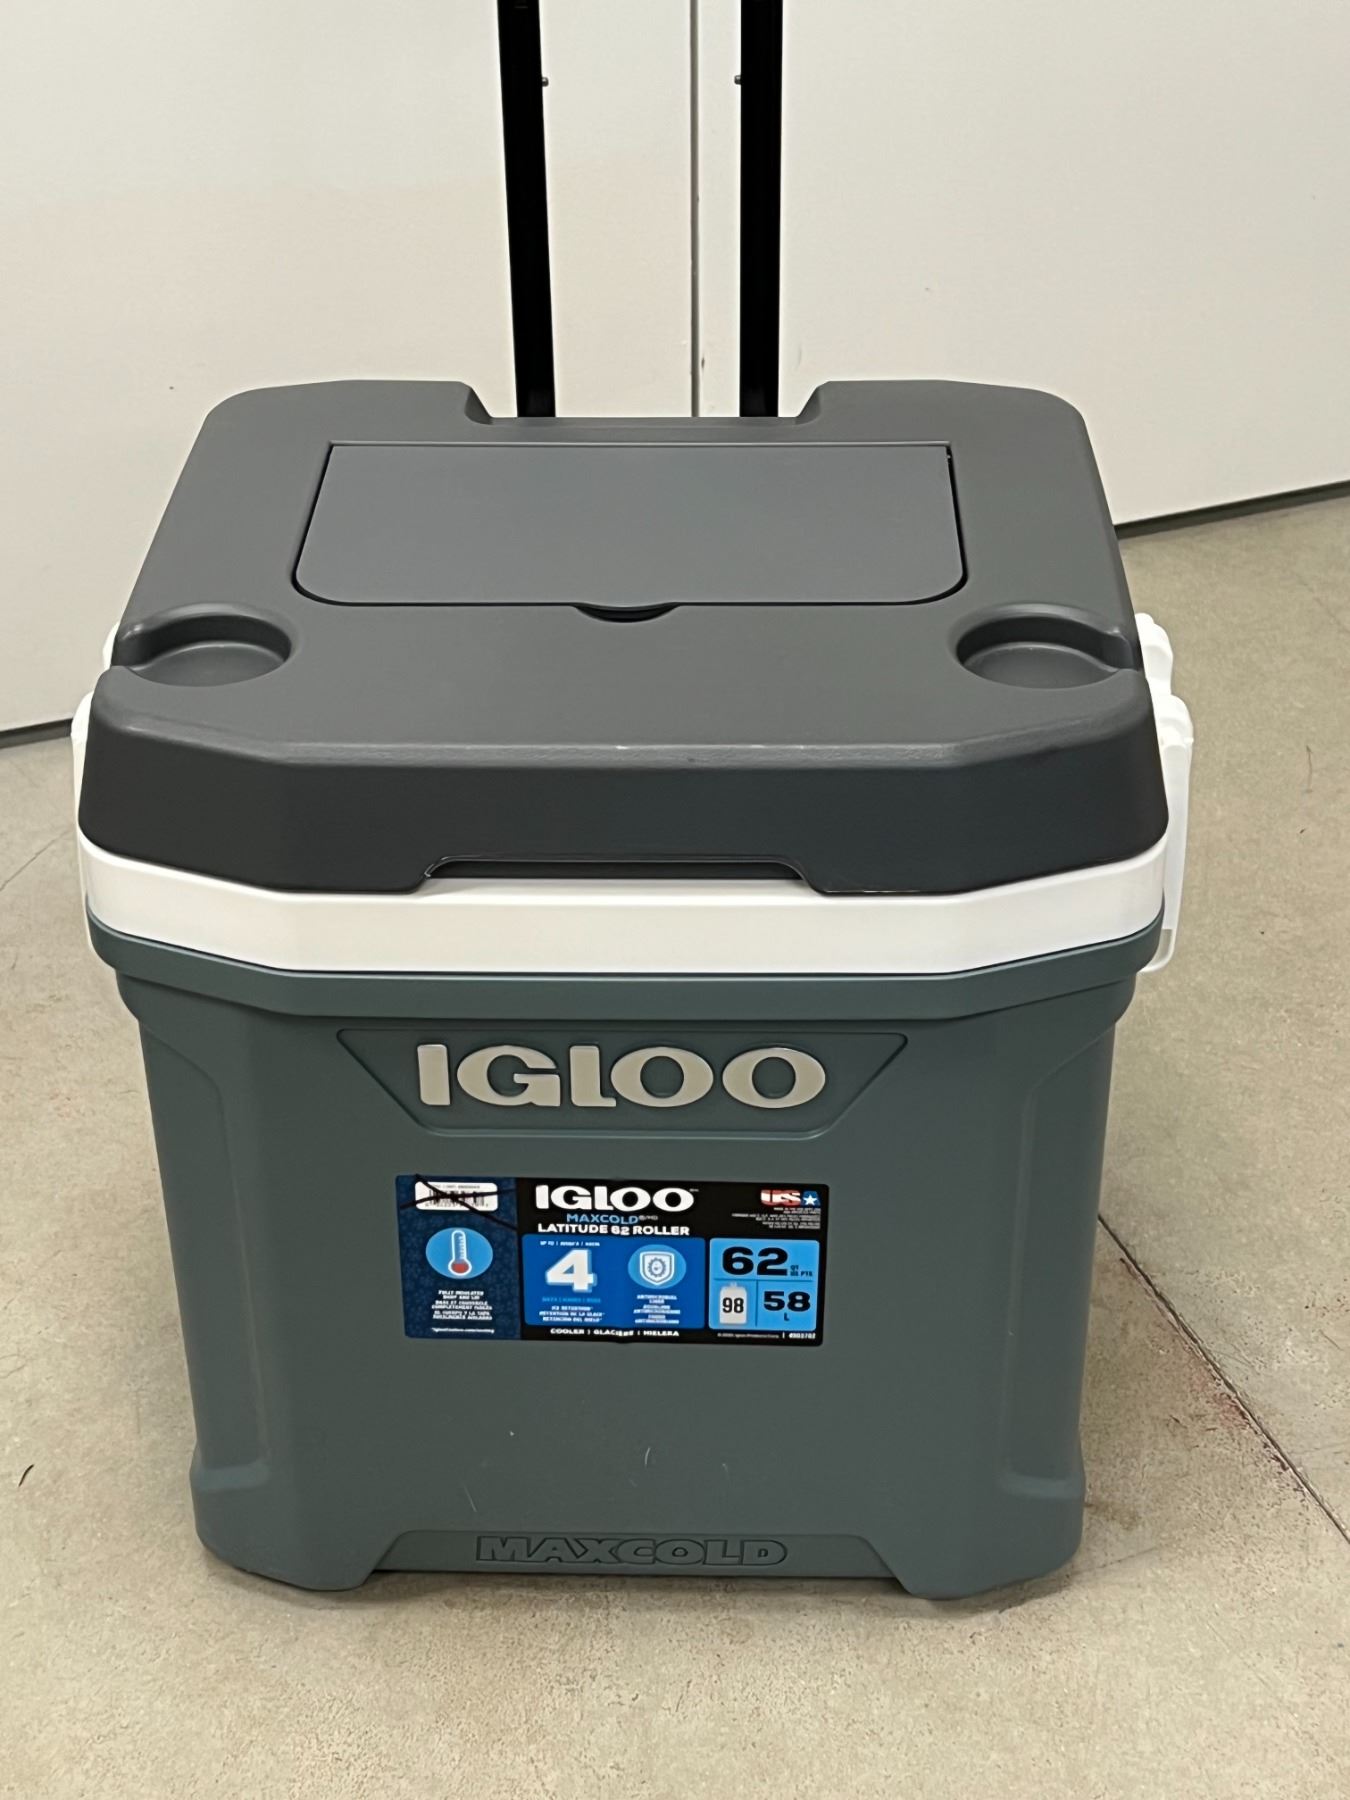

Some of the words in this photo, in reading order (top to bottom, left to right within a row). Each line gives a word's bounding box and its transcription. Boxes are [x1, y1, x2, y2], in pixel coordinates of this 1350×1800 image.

[416, 1043, 827, 1109] IGLOO
[535, 1184, 695, 1212] IGLOO
[537, 1223, 609, 1234] LATITUDE
[632, 1225, 690, 1236] ROLLER
[545, 1248, 597, 1293] 4
[722, 1246, 789, 1276] 62
[722, 1297, 745, 1314] 98
[763, 1290, 811, 1312] 58
[783, 1312, 790, 1321] L
[475, 1535, 789, 1566] MAXCOLD
